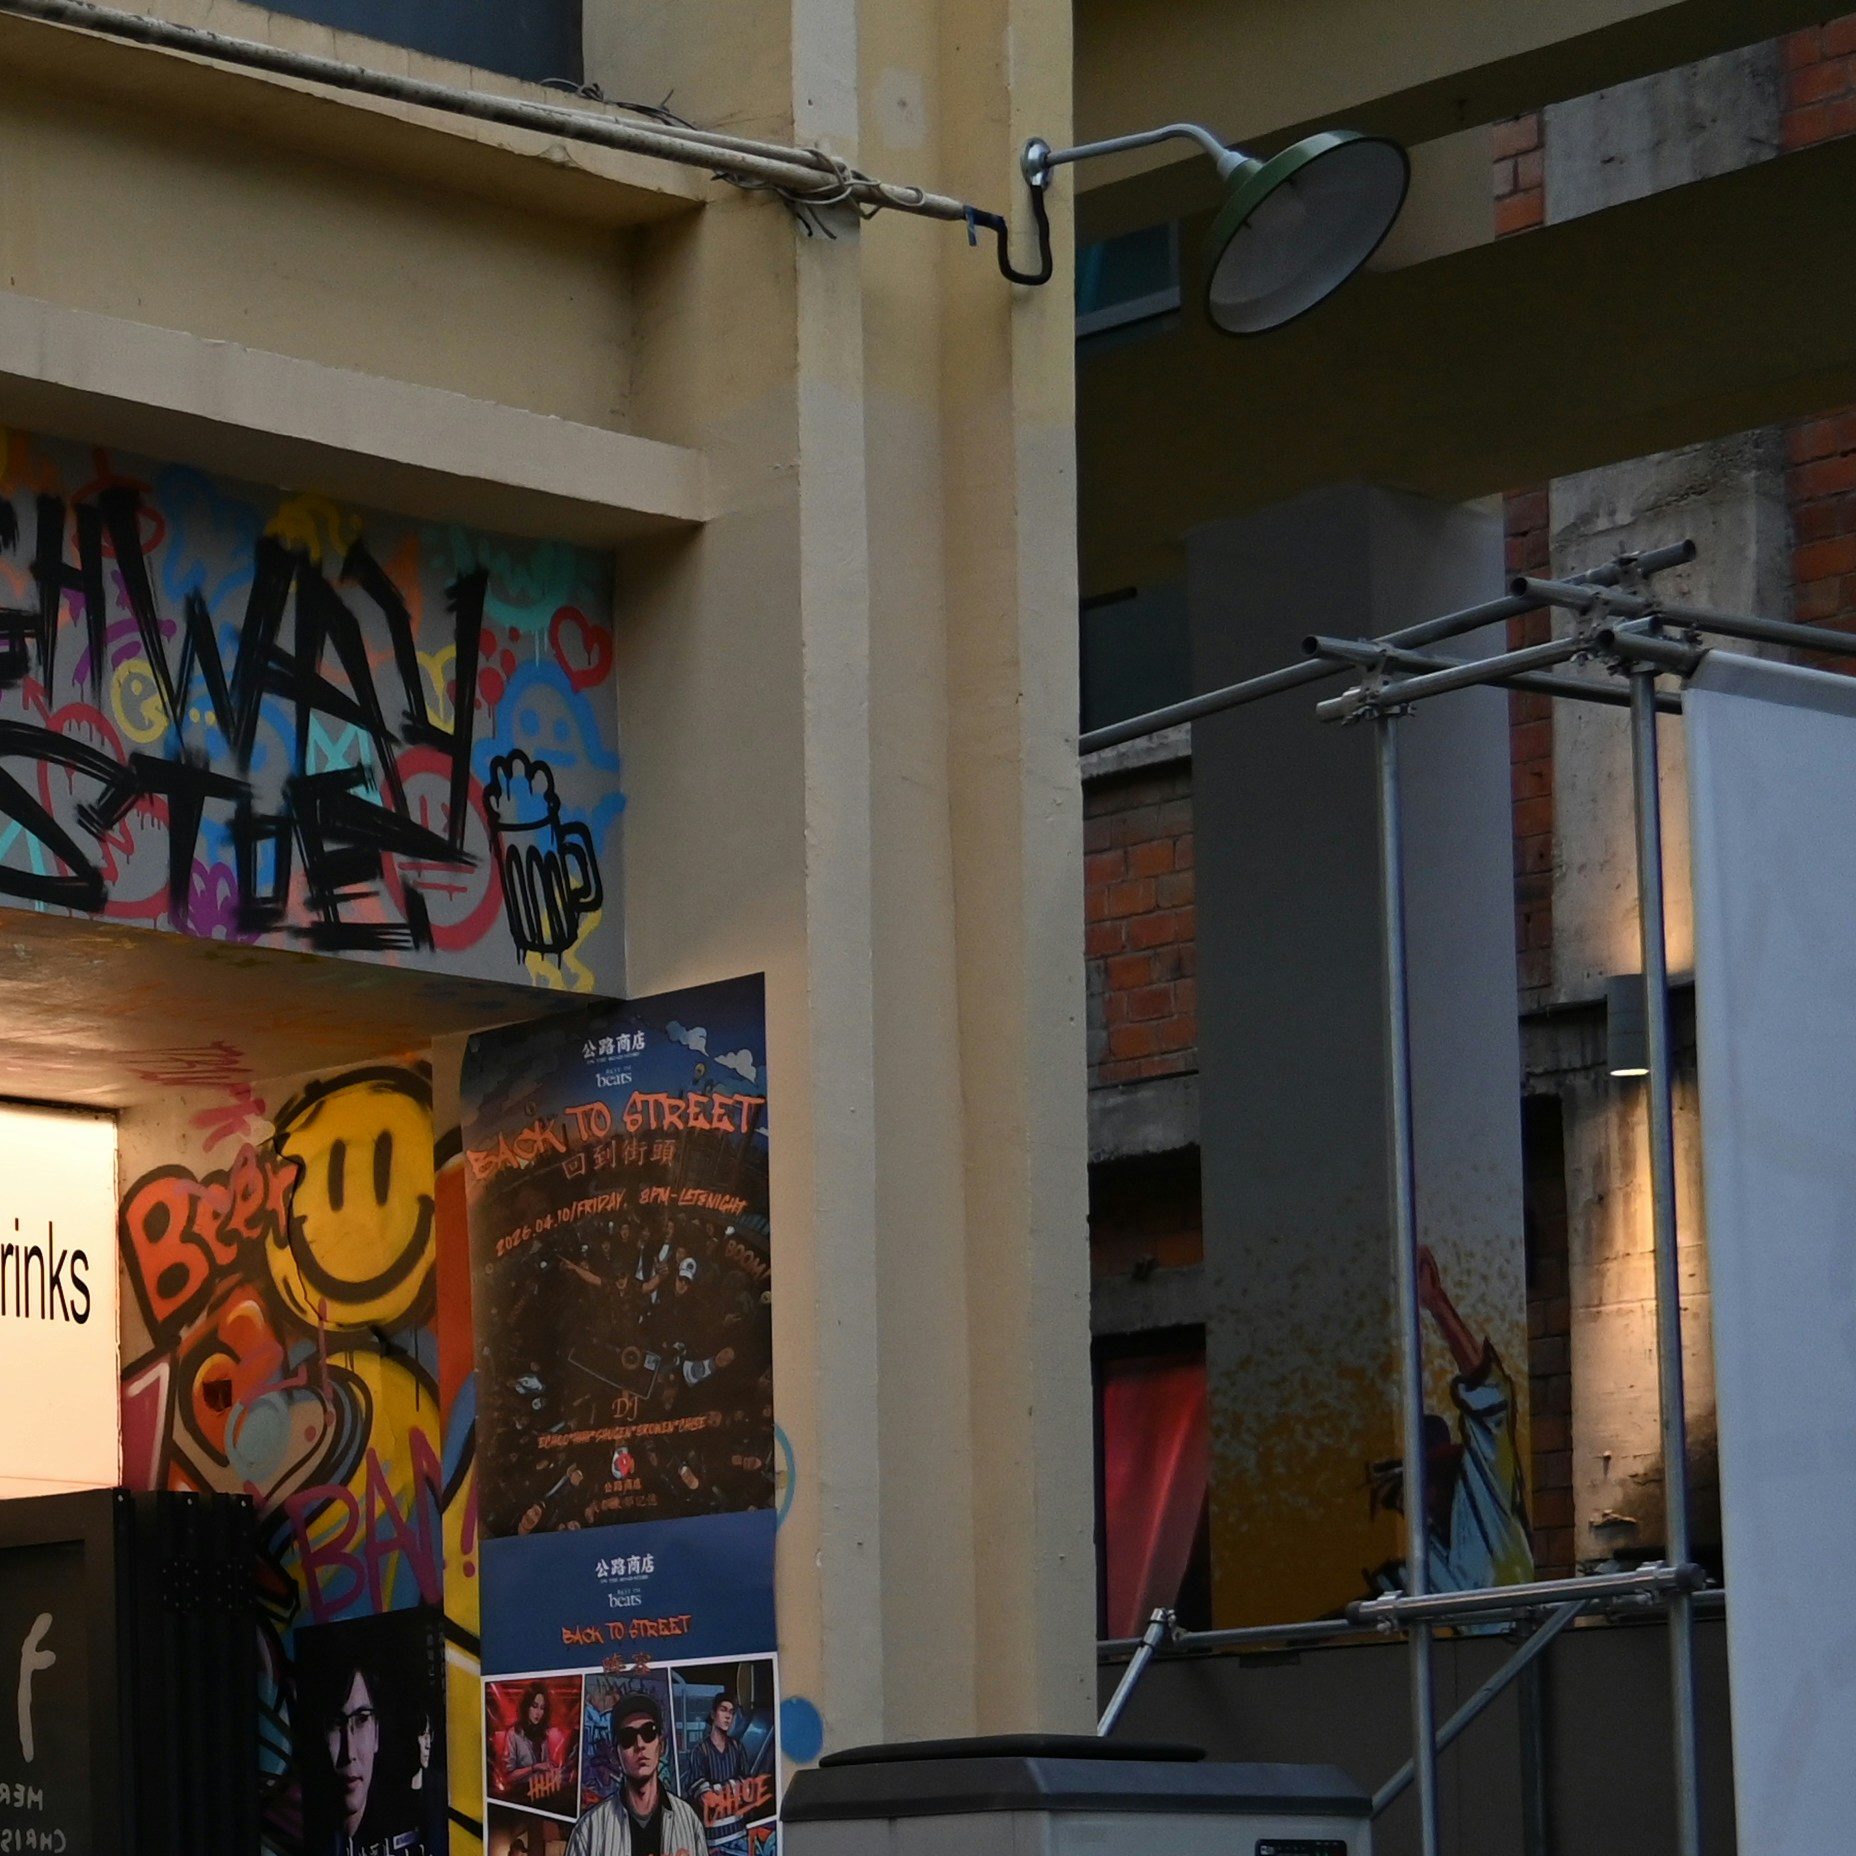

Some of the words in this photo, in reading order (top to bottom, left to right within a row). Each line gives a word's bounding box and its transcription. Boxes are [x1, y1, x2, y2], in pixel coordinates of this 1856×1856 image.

[581, 1030, 647, 1060] 公路商店
[595, 1072, 633, 1089] beats
[468, 1118, 569, 1180] BACK
[564, 1101, 613, 1142] TO
[622, 1090, 767, 1135] STREET
[612, 1396, 639, 1422] DJ
[595, 1553, 655, 1578] 公路商店
[608, 1594, 642, 1608] beats
[561, 1625, 604, 1645] BACK
[604, 1621, 625, 1640] TO
[629, 1615, 693, 1640] STREET
